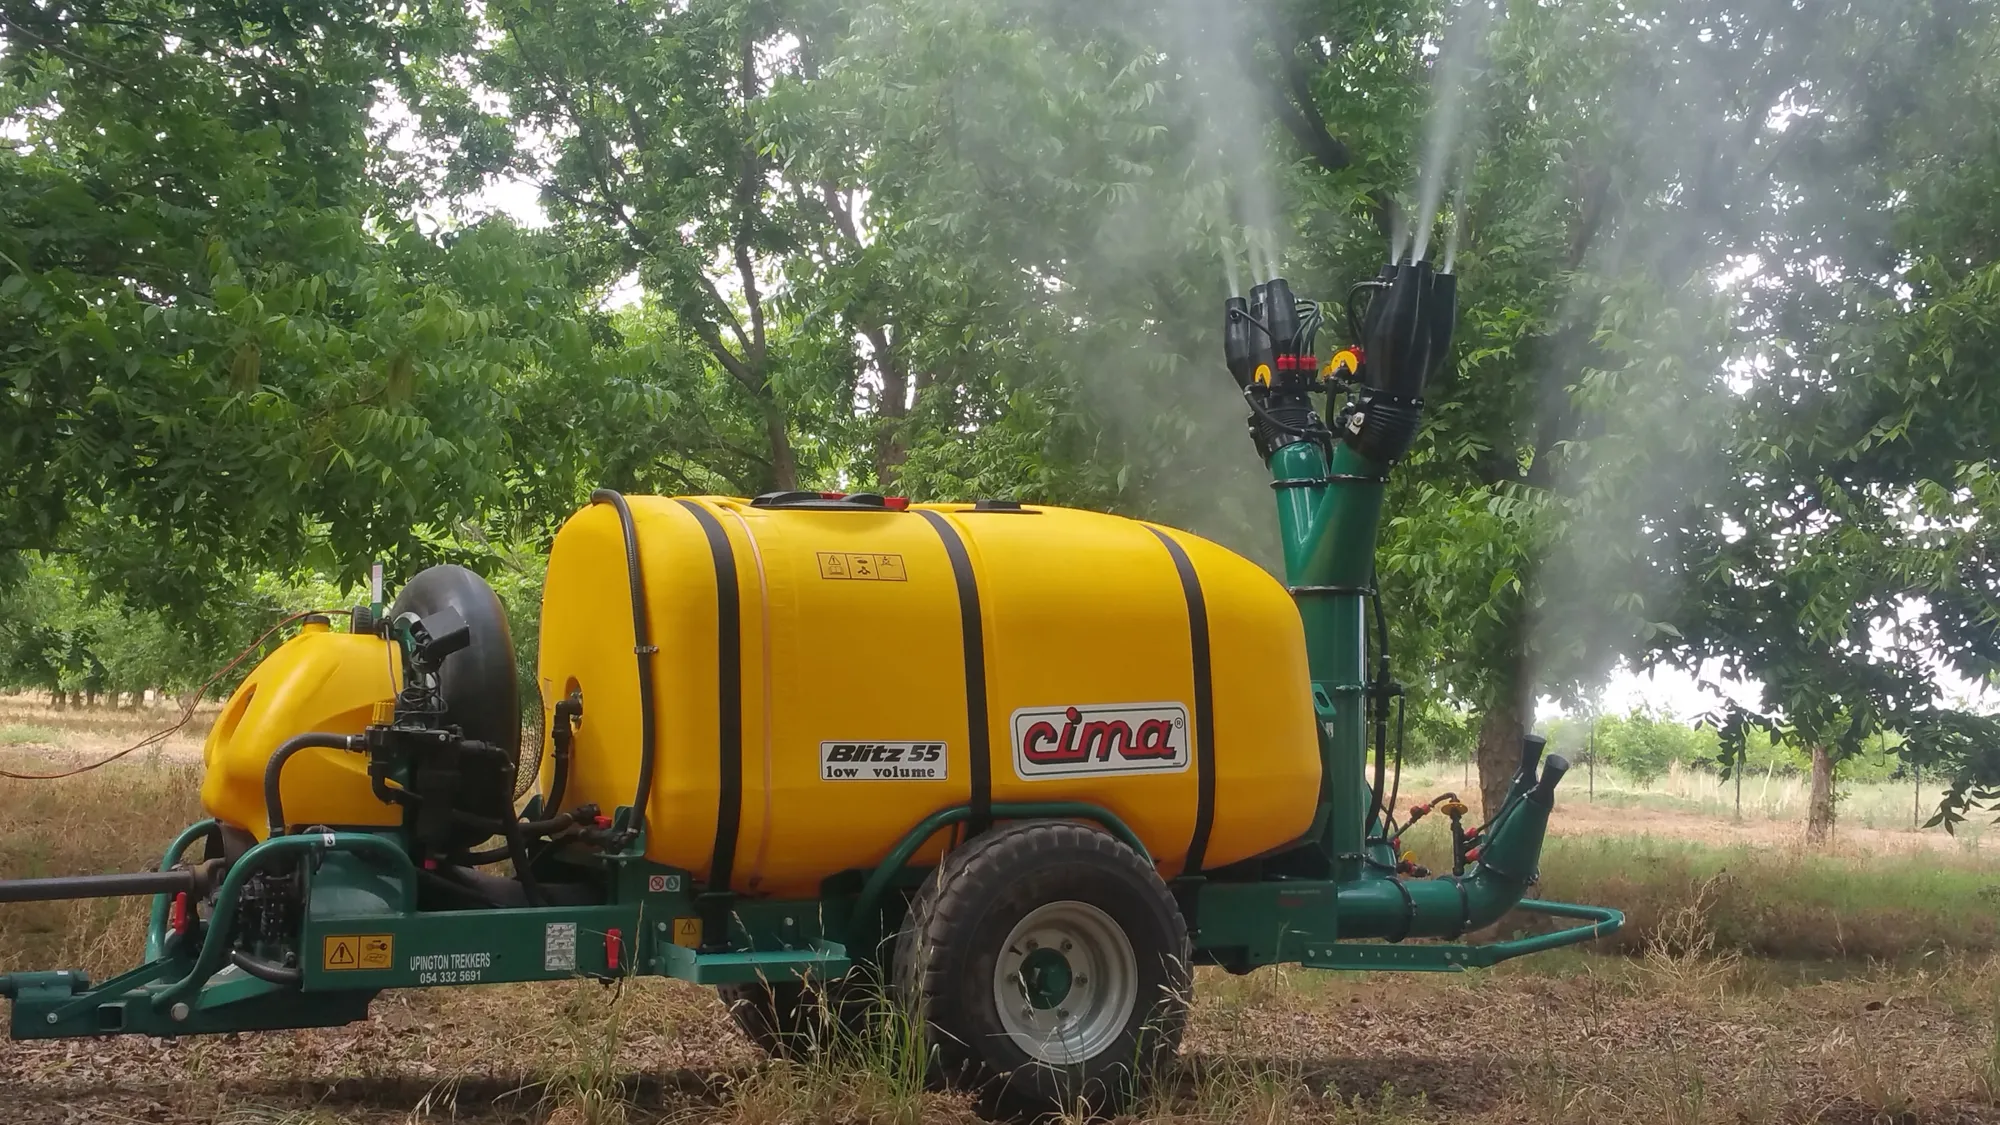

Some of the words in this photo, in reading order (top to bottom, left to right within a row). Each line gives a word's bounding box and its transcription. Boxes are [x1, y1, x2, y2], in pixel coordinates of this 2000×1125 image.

[1023, 706, 1176, 765] cima
[826, 744, 905, 762] Blitz
[907, 744, 942, 762] 55
[826, 765, 859, 778] low
[872, 765, 935, 778] volume
[410, 954, 449, 972] UPINGTON
[450, 952, 491, 969] TREKKERS
[420, 972, 437, 984] 054
[440, 971, 457, 983] 332
[459, 970, 481, 982] 5691
